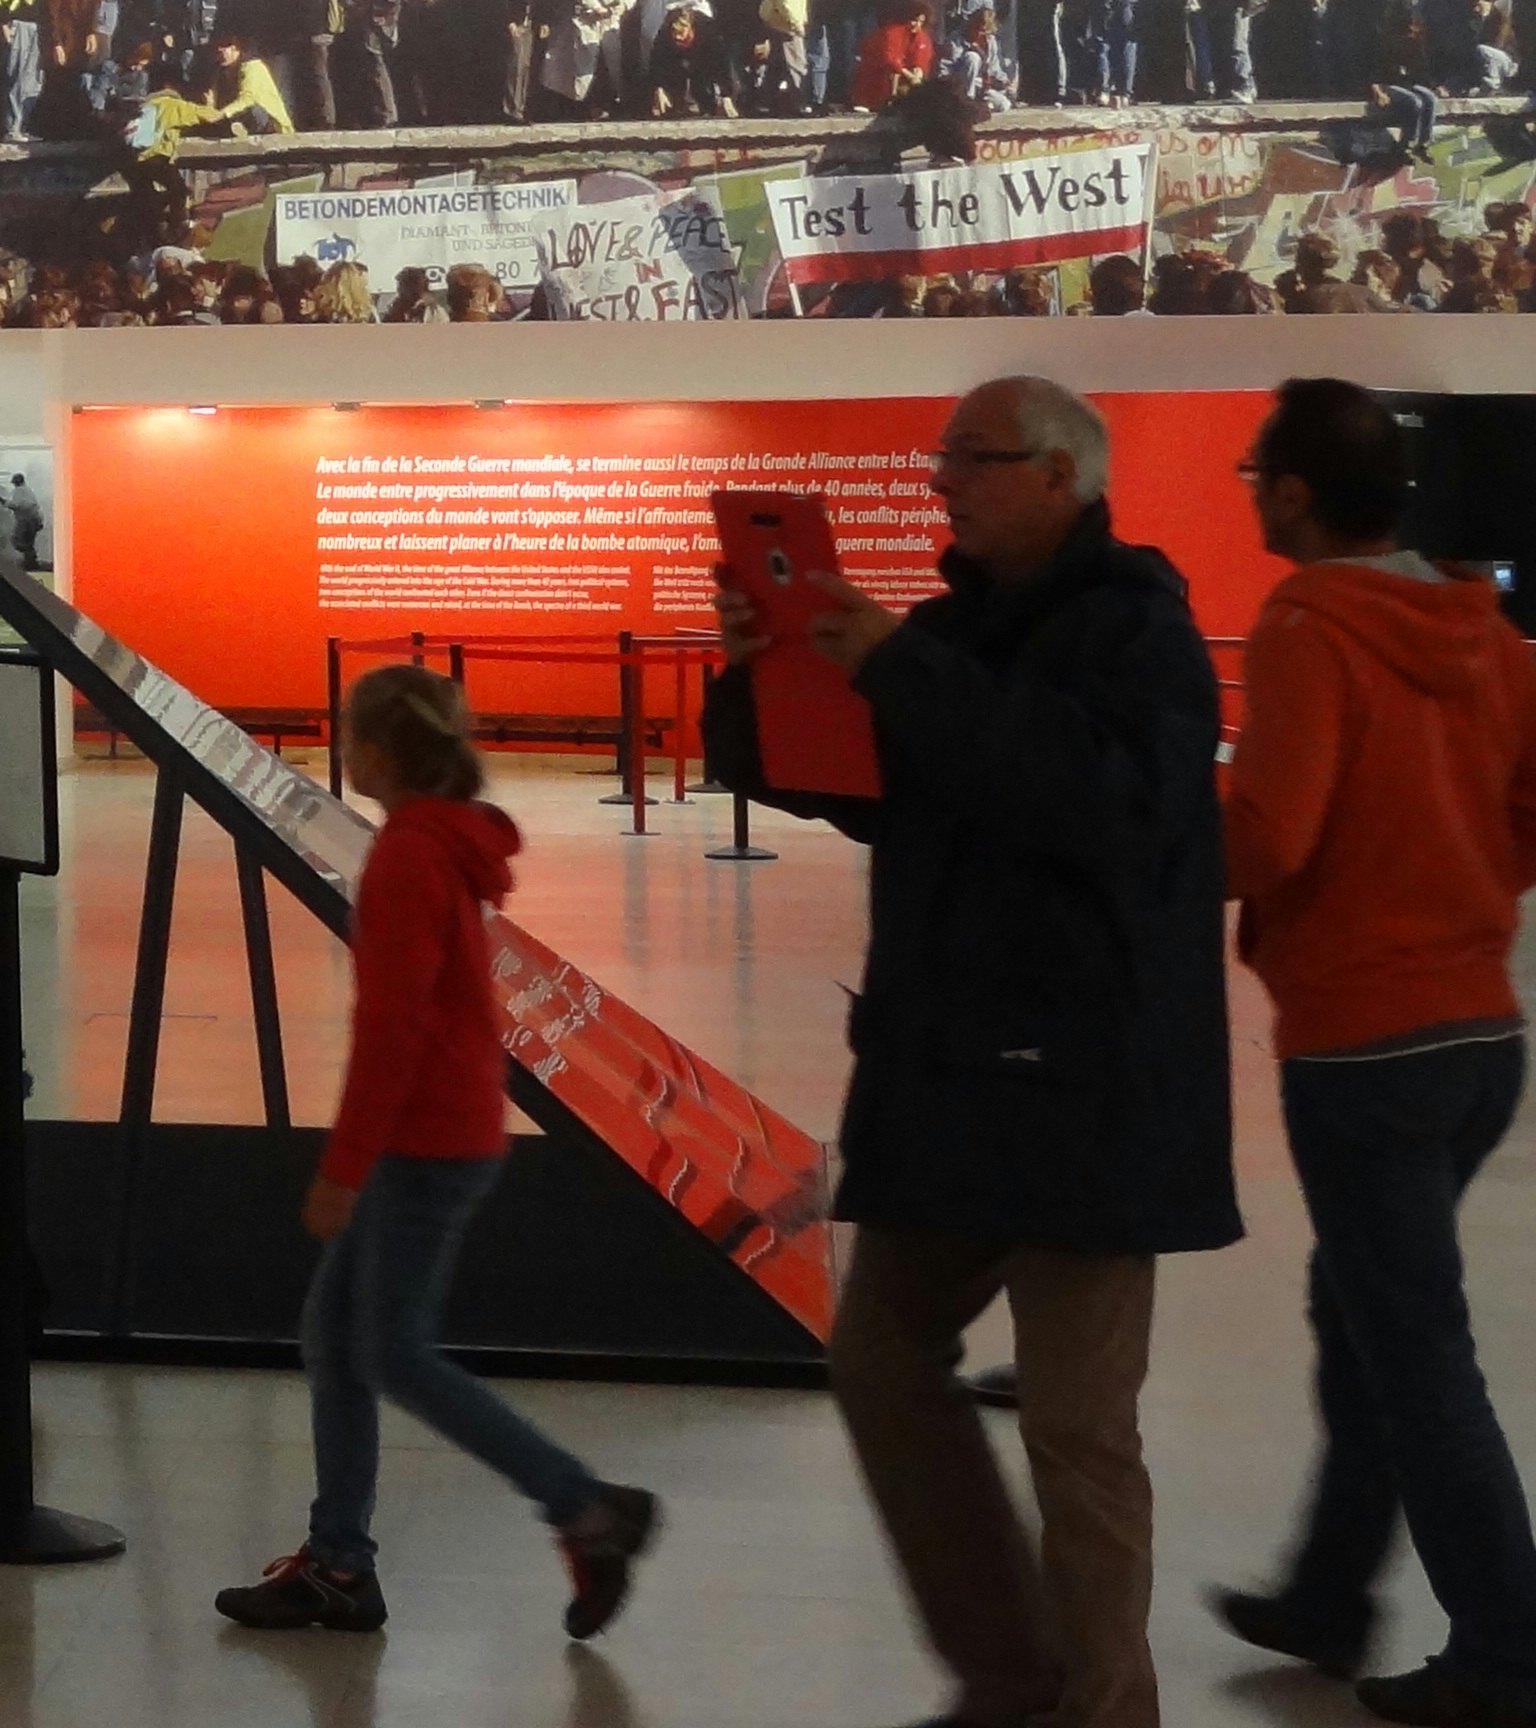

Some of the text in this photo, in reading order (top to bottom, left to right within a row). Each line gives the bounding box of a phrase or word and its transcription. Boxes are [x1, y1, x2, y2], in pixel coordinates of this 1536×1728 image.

[284, 186, 567, 220] BETONDEMONTAGETECHNIK
[779, 186, 874, 241] Test
[897, 183, 979, 232] the
[634, 259, 664, 284] IN
[316, 456, 345, 473] Avec
[347, 456, 360, 472] la
[362, 456, 380, 472] fin
[381, 456, 398, 472] de
[399, 456, 412, 472] la
[413, 456, 465, 472] Seconde
[468, 455, 510, 472] Guerre
[576, 459, 590, 472] se
[592, 455, 641, 472] termine
[643, 454, 675, 471] aussi
[677, 454, 689, 471] le
[691, 456, 728, 474] temps
[730, 453, 746, 470] de
[748, 453, 759, 470] la
[762, 452, 806, 470] Grande
[808, 451, 856, 470] Alliance
[858, 454, 889, 470] entre
[890, 450, 906, 469] les
[908, 448, 932, 469] Éta
[316, 482, 332, 499] Le
[333, 481, 377, 498] monde
[379, 483, 413, 499] entre
[414, 481, 518, 502] progressivement
[520, 481, 550, 498] dans
[607, 480, 623, 498] de
[624, 480, 637, 498] la
[639, 480, 681, 498] Guerre
[824, 479, 840, 496] 40
[889, 479, 917, 496] deux
[317, 507, 349, 524] deux
[350, 507, 424, 528] conceptions
[425, 507, 443, 524] du
[445, 507, 489, 524] monde
[491, 508, 519, 524] vont
[583, 507, 623, 524] Même
[625, 507, 636, 524] si
[637, 507, 716, 524] l'affronteme
[838, 506, 854, 524] les
[856, 505, 899, 524] conflits
[318, 533, 383, 551] nombreux
[384, 534, 398, 551] et
[399, 533, 448, 551] laissent
[449, 533, 491, 554] planer
[493, 533, 501, 551] à
[548, 533, 564, 551] de
[566, 533, 579, 551] la
[581, 533, 625, 551] bombe
[835, 538, 873, 555] guerre
